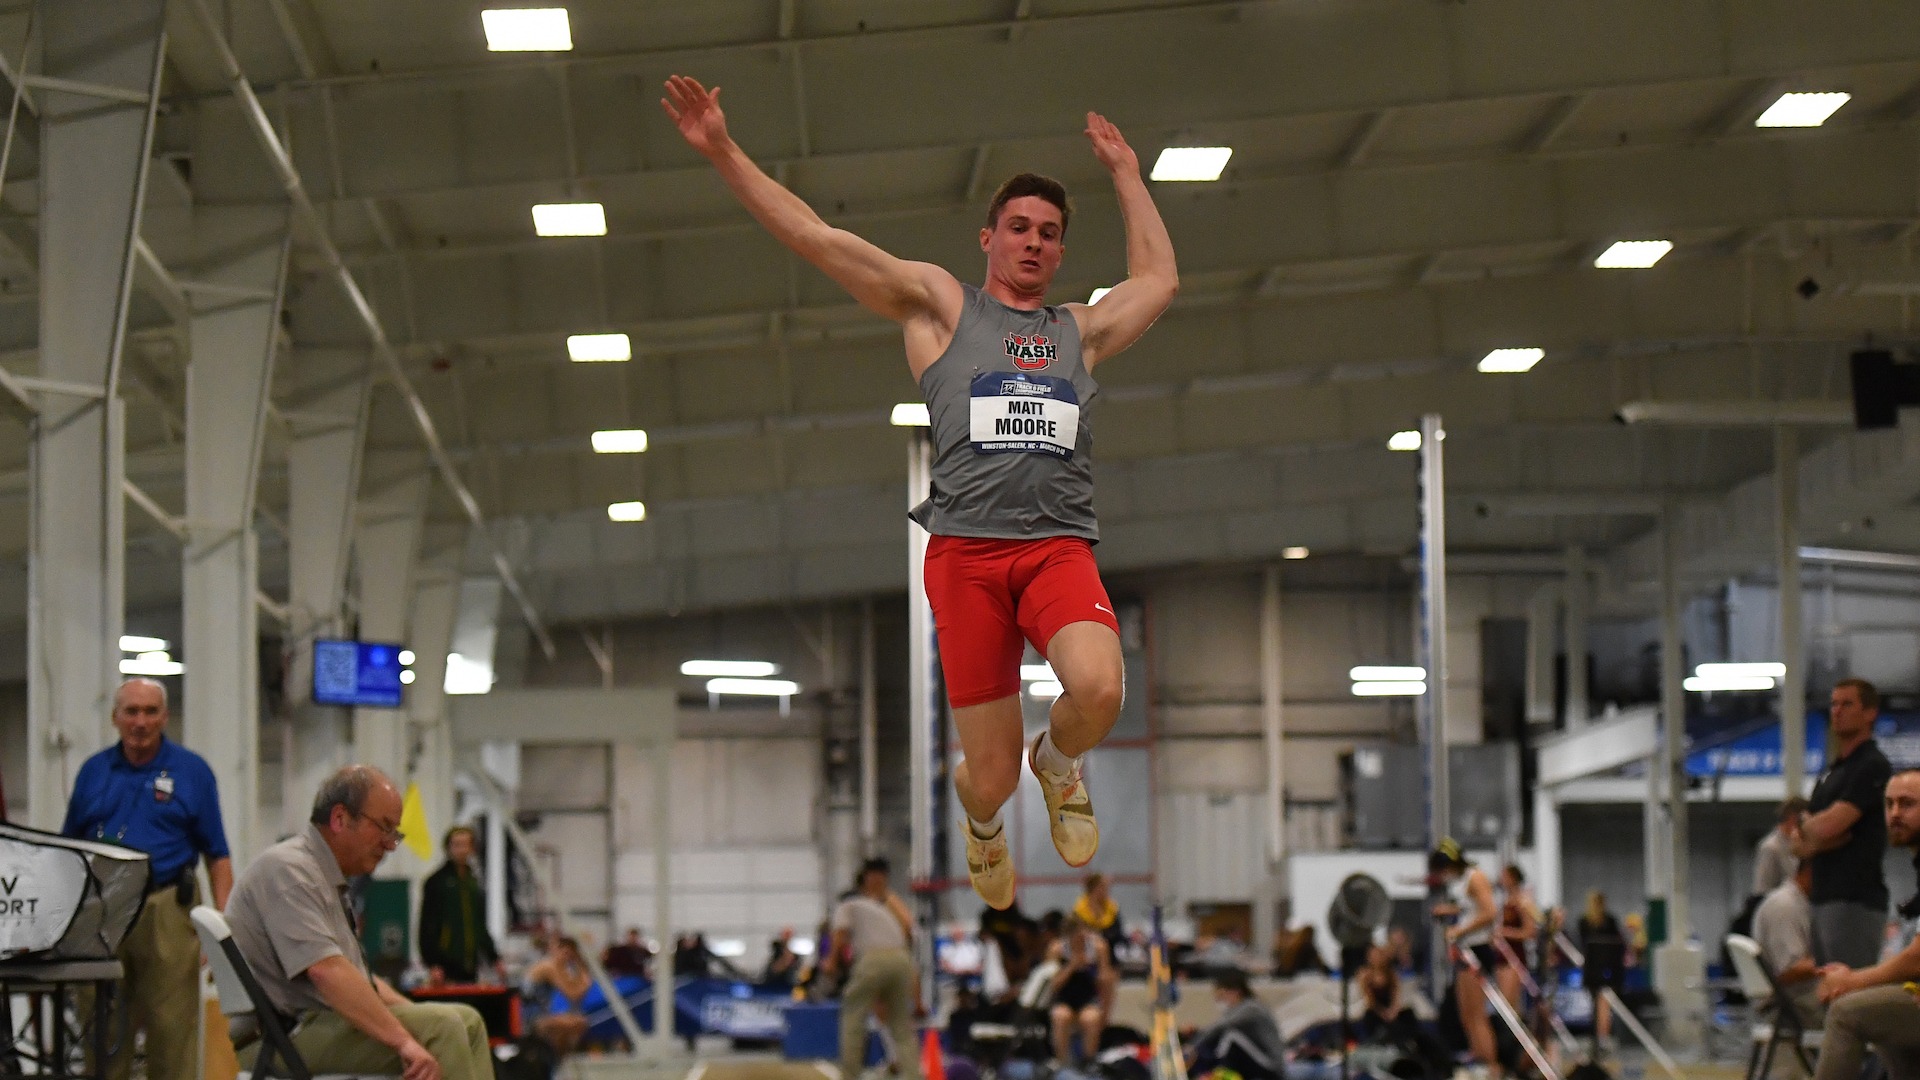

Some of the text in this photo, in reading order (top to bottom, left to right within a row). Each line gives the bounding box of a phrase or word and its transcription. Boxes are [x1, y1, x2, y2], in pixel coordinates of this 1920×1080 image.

[1004, 339, 1058, 361] WASH
[1008, 401, 1045, 415] MATT
[995, 418, 1057, 438] MOORE
[1027, 442, 1036, 450] NC
